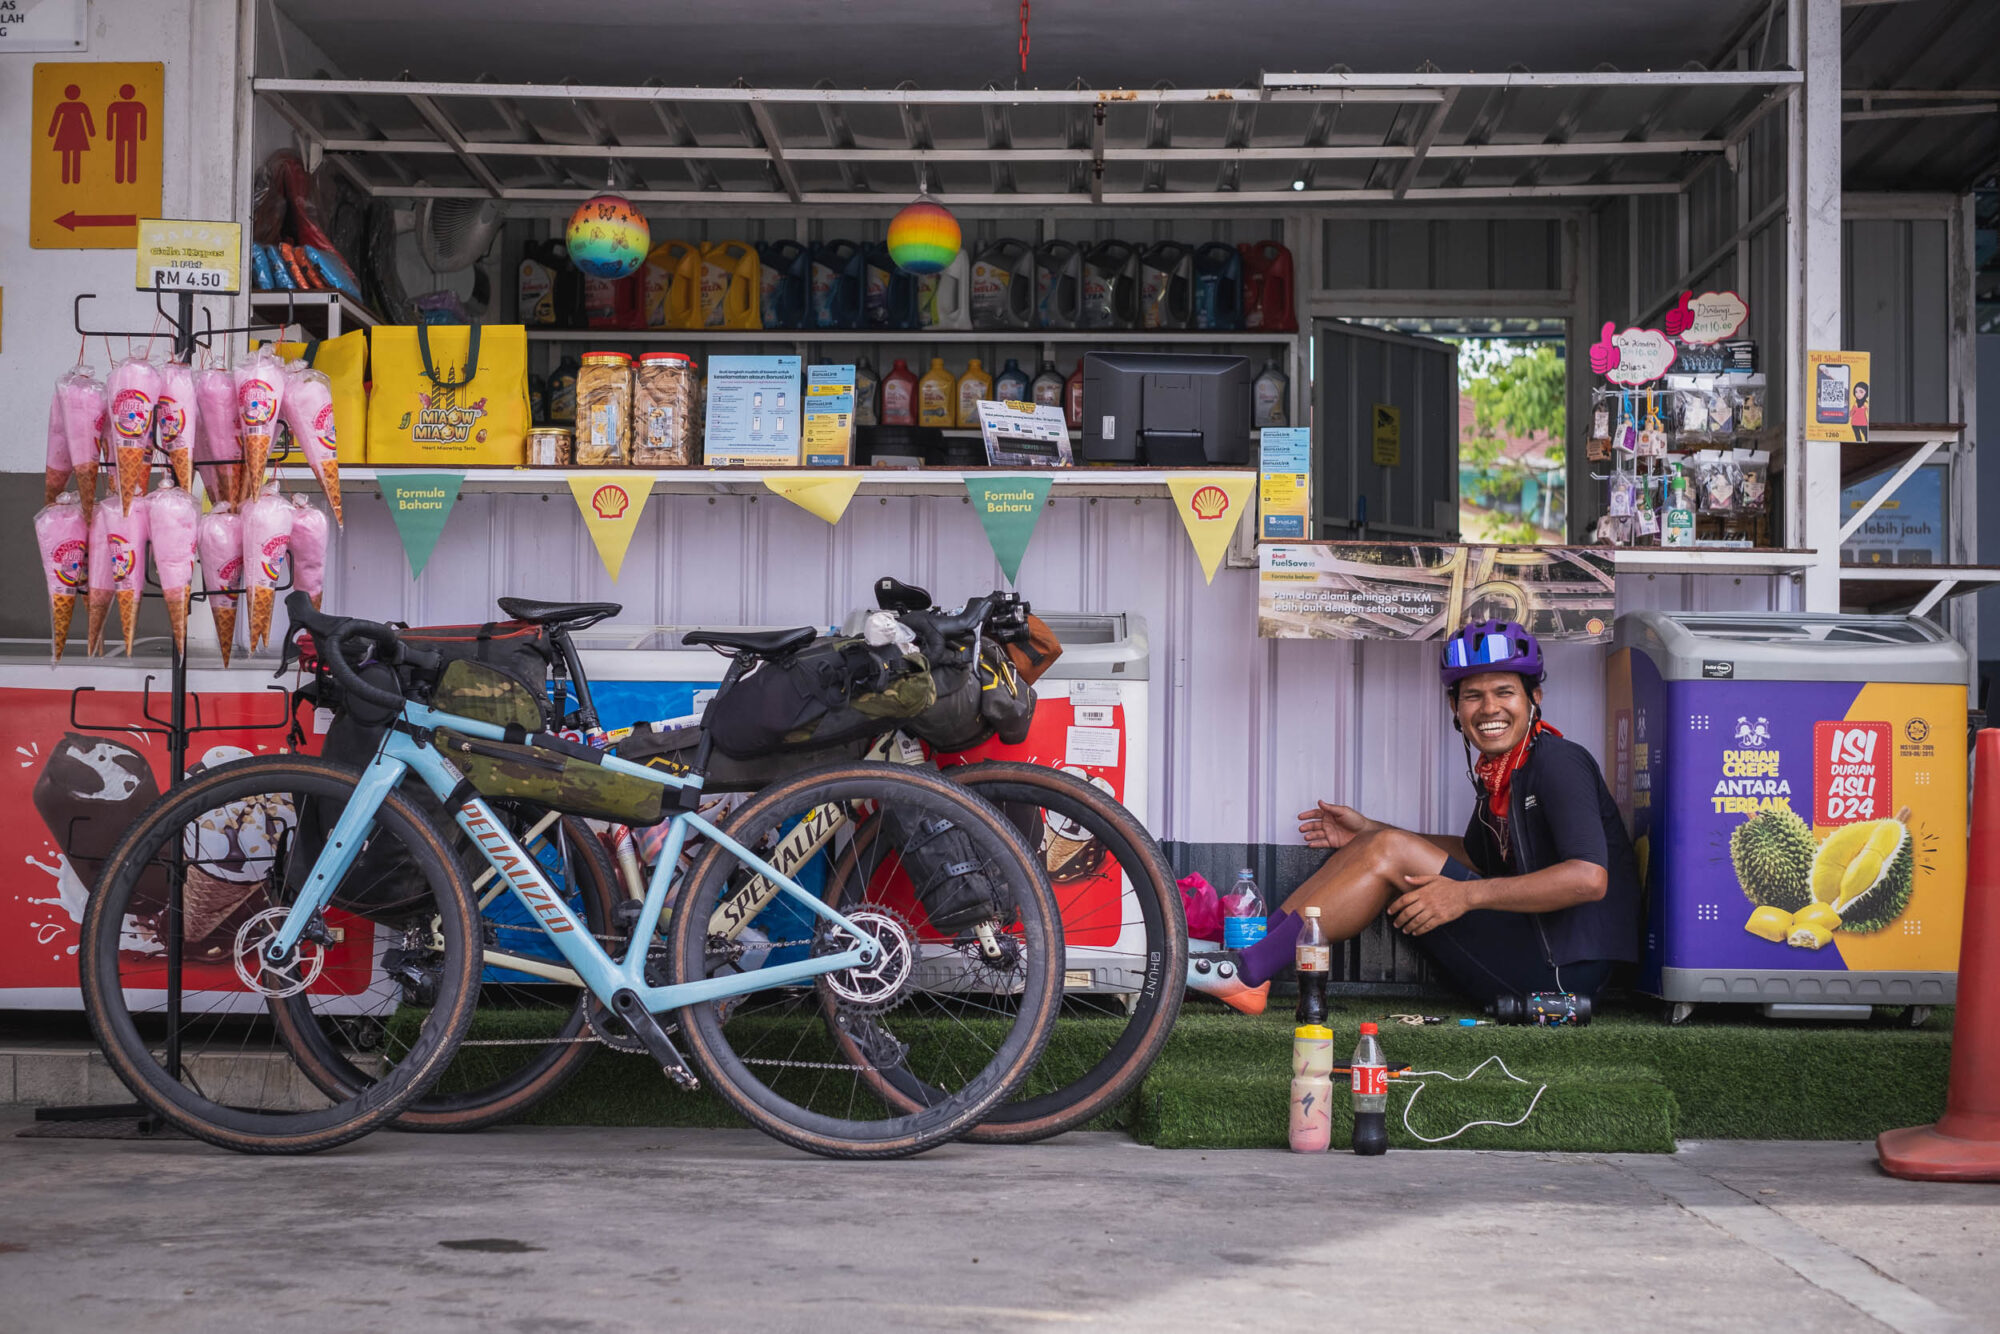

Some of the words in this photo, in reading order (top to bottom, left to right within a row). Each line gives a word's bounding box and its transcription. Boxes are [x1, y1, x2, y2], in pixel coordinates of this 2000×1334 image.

[156, 270, 180, 285] RM
[186, 272, 220, 287] 4.50
[421, 408, 475, 426] MIAOW
[414, 424, 468, 440] MIAOW
[396, 487, 445, 498] Formula
[984, 489, 1034, 501] Formula
[399, 499, 442, 510] Baharu
[987, 501, 1032, 512] Baharu
[1864, 522, 1897, 534] lebih
[1902, 522, 1931, 536] jauh
[1298, 592, 1317, 600] dan
[1320, 592, 1349, 600] alami
[1352, 592, 1398, 603] sehingga
[1401, 593, 1412, 601] 15
[1414, 593, 1432, 602] KM
[1300, 601, 1322, 613] jauh
[1324, 602, 1364, 614] dengan
[1366, 604, 1397, 615] setiap
[1400, 605, 1434, 616] tangki
[1830, 728, 1878, 763] ISI
[1723, 750, 1779, 763] DURIAN
[1723, 763, 1779, 777] CREPE
[1831, 765, 1875, 775] DURIAN
[1714, 779, 1791, 795] ANTARA
[1828, 776, 1875, 797] ASLI
[1711, 797, 1791, 813] TERBAIK
[1827, 798, 1874, 819] D24
[461, 804, 574, 933] PECIALIZED
[724, 802, 840, 932] SPECIALIZE
[1145, 962, 1160, 998] HUNT
